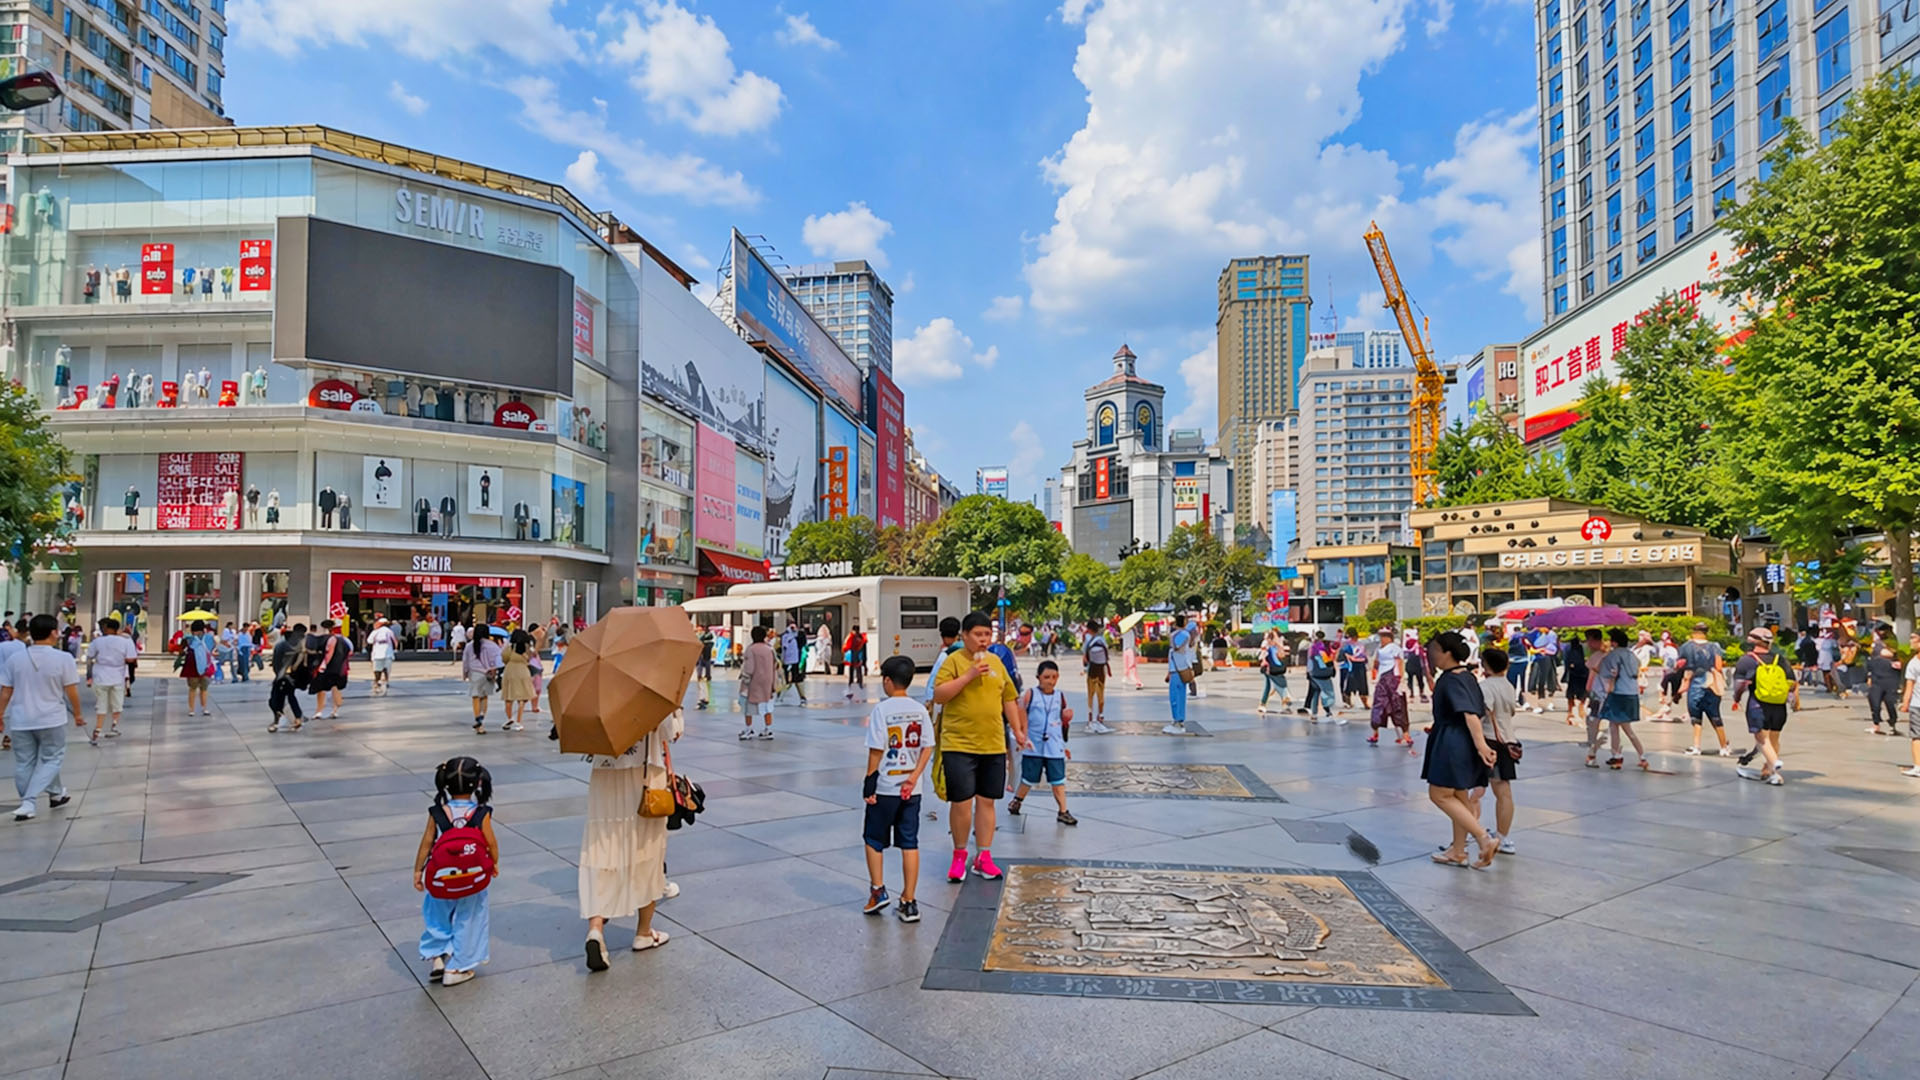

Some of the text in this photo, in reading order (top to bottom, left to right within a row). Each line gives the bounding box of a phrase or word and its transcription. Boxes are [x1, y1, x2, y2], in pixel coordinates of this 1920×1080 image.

[396, 188, 484, 240] SEMIR
[320, 388, 354, 403] sale
[502, 410, 531, 424] sale
[214, 464, 240, 475] SALE
[412, 555, 452, 572] SEMIR
[1501, 548, 1604, 568] CHAGEE
[463, 843, 477, 855] 95
